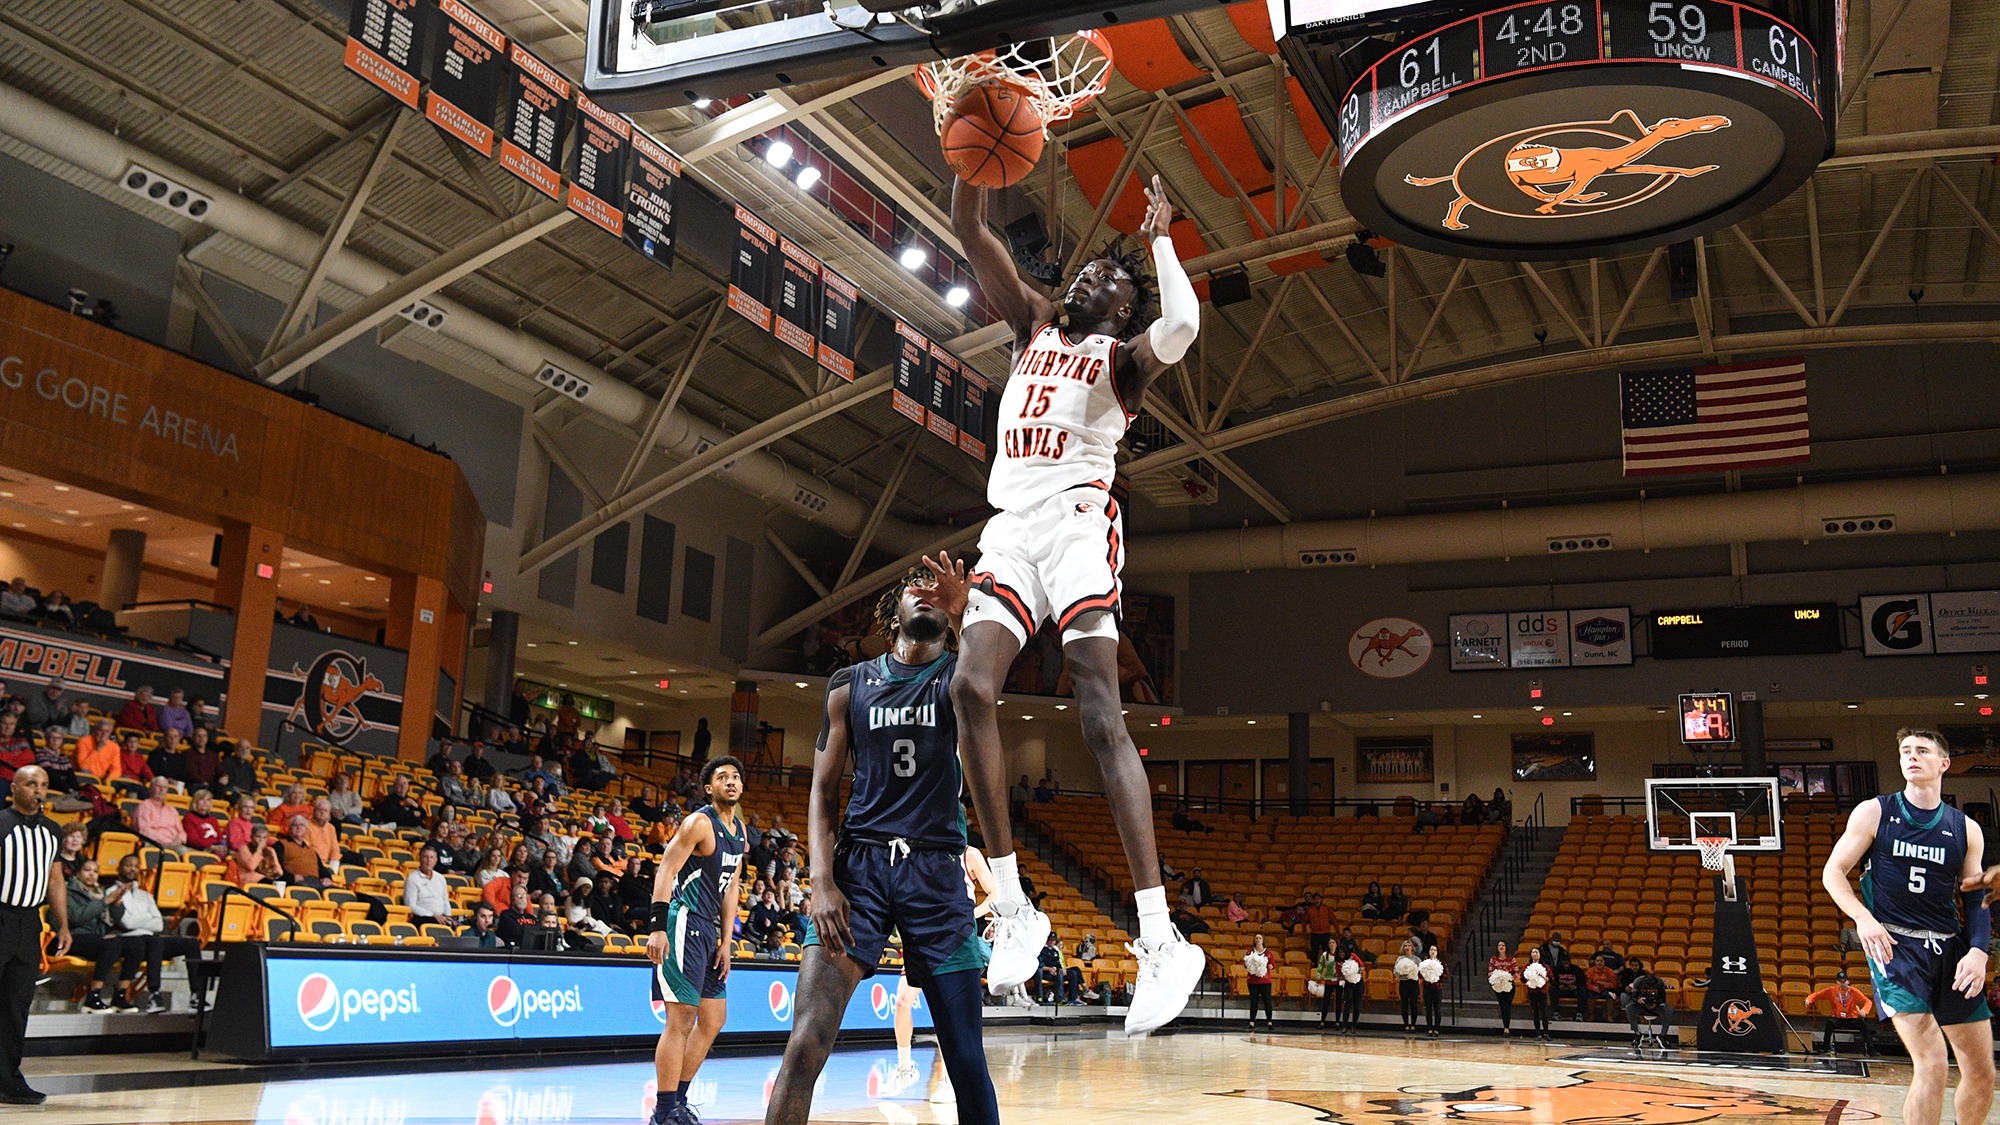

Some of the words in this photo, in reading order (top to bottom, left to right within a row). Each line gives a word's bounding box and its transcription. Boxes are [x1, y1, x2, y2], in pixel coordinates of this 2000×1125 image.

[443, 0, 502, 48] CAMPBELL
[1304, 12, 1366, 30] DAKTRONICS
[1495, 4, 1584, 45] 4:48
[1647, 2, 1707, 45] 59
[448, 22, 492, 61] WOMEN'S
[453, 39, 483, 65] GOLF
[1516, 42, 1567, 67] 2ND
[1653, 43, 1711, 62] UNCW
[1768, 24, 1802, 75] 61
[355, 56, 409, 96] CHAMPIONS
[356, 48, 413, 89] CONFERENCE
[513, 48, 566, 95] CAMPBELL
[1398, 36, 1441, 89] 61
[519, 73, 558, 108] WOMEN'S
[1752, 57, 1812, 99] CAMPBELL
[523, 89, 550, 113] GOLF
[1383, 71, 1462, 117] CAMPBELL
[435, 109, 484, 145] CHAMPIONS
[436, 102, 487, 139] CONFERENCE
[517, 106, 533, 120] 1997
[577, 95, 628, 136] CAMPBELL
[1341, 93, 1359, 145] 59
[583, 117, 620, 149] WOMEN'S
[588, 133, 613, 154] GOLF
[520, 154, 542, 174] NCAA
[633, 134, 679, 174] CAMPBELL
[504, 153, 555, 192] TOURNAMENT
[639, 157, 672, 186] WOMEN'S
[645, 172, 665, 191] GOLF
[572, 196, 619, 229] TOURNAMENT
[586, 196, 607, 214] NCAA
[629, 191, 672, 226] CROOKS
[647, 192, 673, 213] JOHN
[627, 212, 660, 238] TOURNAMENT
[736, 207, 775, 242] CAMPBELL
[740, 227, 769, 255] SOFTBALL
[781, 241, 818, 270] CAMPBELL
[784, 259, 813, 284] SOFTBALL
[823, 270, 856, 298] CAMPBELL
[895, 322, 926, 350] CAMPBELL
[35, 368, 129, 425] GORE
[138, 404, 239, 463] ARENA
[1019, 383, 1059, 420] 15
[1517, 614, 1558, 633] dds
[1578, 625, 1621, 638] Hampton
[1657, 614, 1704, 626] CAMPBELL
[1793, 609, 1820, 620] UNCW
[1589, 633, 1610, 643] Inn
[1721, 640, 1749, 649] PERIOD
[1584, 650, 1606, 658] Dunn,
[1607, 649, 1618, 657] NC
[869, 702, 936, 731] UNCW
[892, 738, 917, 778] 3
[1892, 838, 1946, 866] UNCW
[1908, 865, 1927, 894] 5
[342, 982, 419, 1023] pepsi
[523, 984, 582, 1020] pepsi
